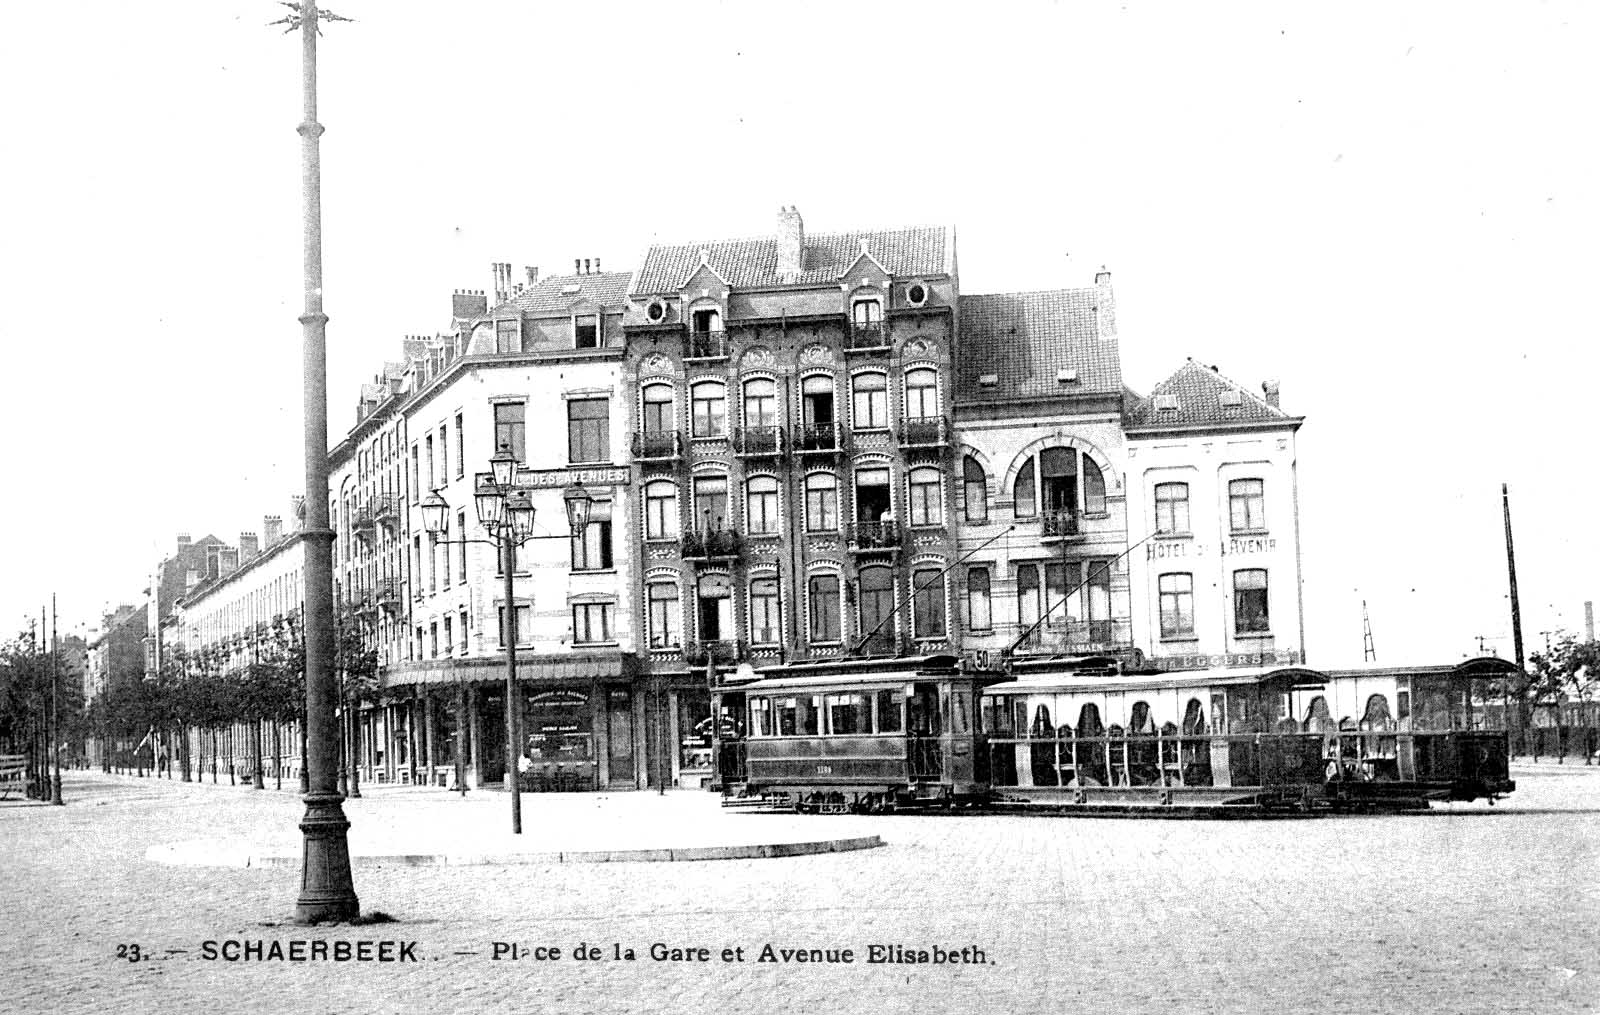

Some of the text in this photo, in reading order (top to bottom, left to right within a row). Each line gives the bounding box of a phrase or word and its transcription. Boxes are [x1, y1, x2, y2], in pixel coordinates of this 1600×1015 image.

[530, 472, 556, 486] DES
[565, 468, 625, 485] AVENUES
[975, 649, 988, 668] 50
